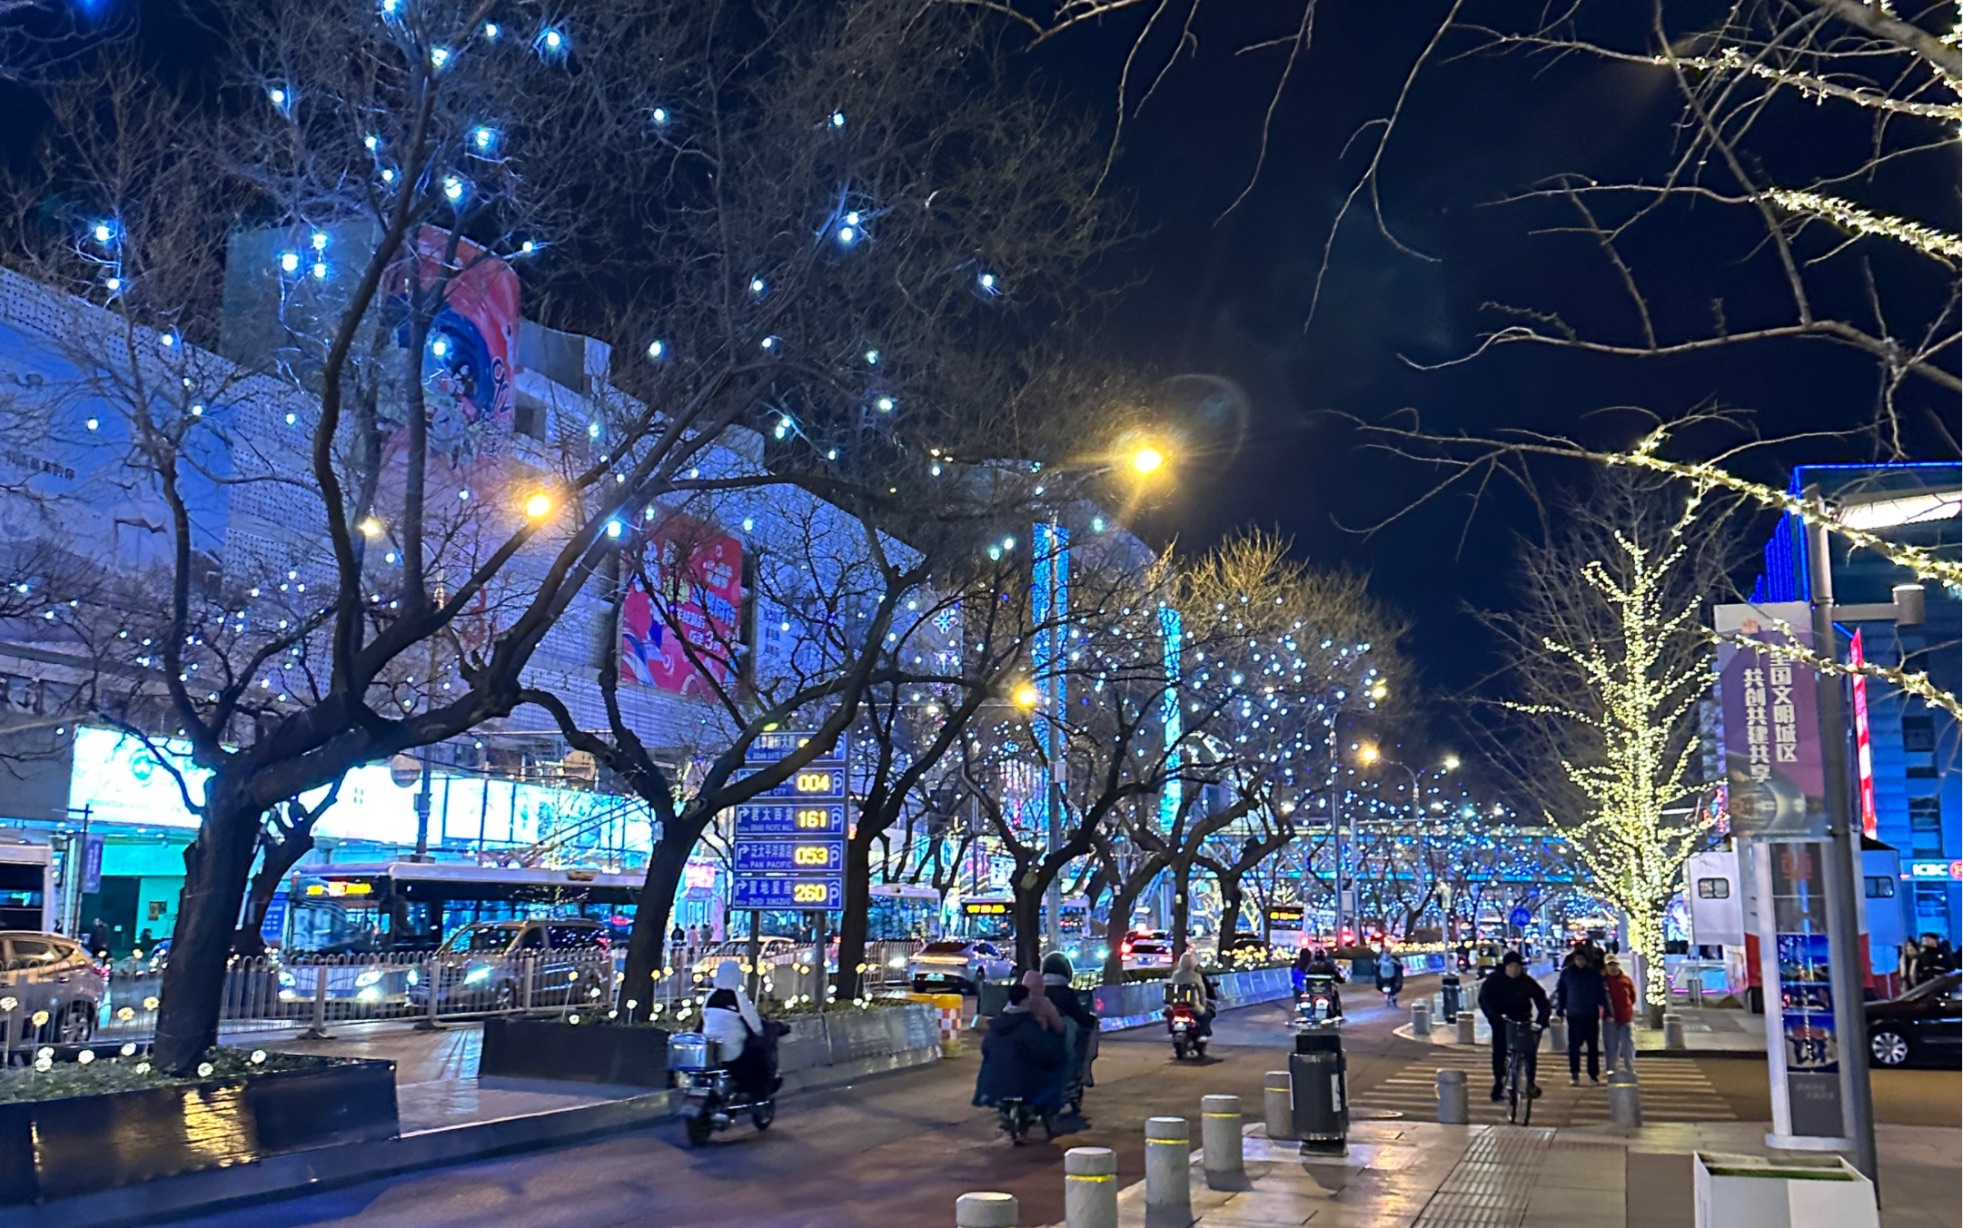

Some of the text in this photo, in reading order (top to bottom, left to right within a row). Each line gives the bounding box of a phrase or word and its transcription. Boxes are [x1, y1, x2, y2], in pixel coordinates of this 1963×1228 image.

[1744, 668, 1771, 784] 共创共建共享
[797, 774, 830, 792] 004
[798, 810, 827, 828] 161
[795, 847, 828, 864] 053
[1912, 864, 1948, 876] ICBC
[794, 884, 827, 902] 260
